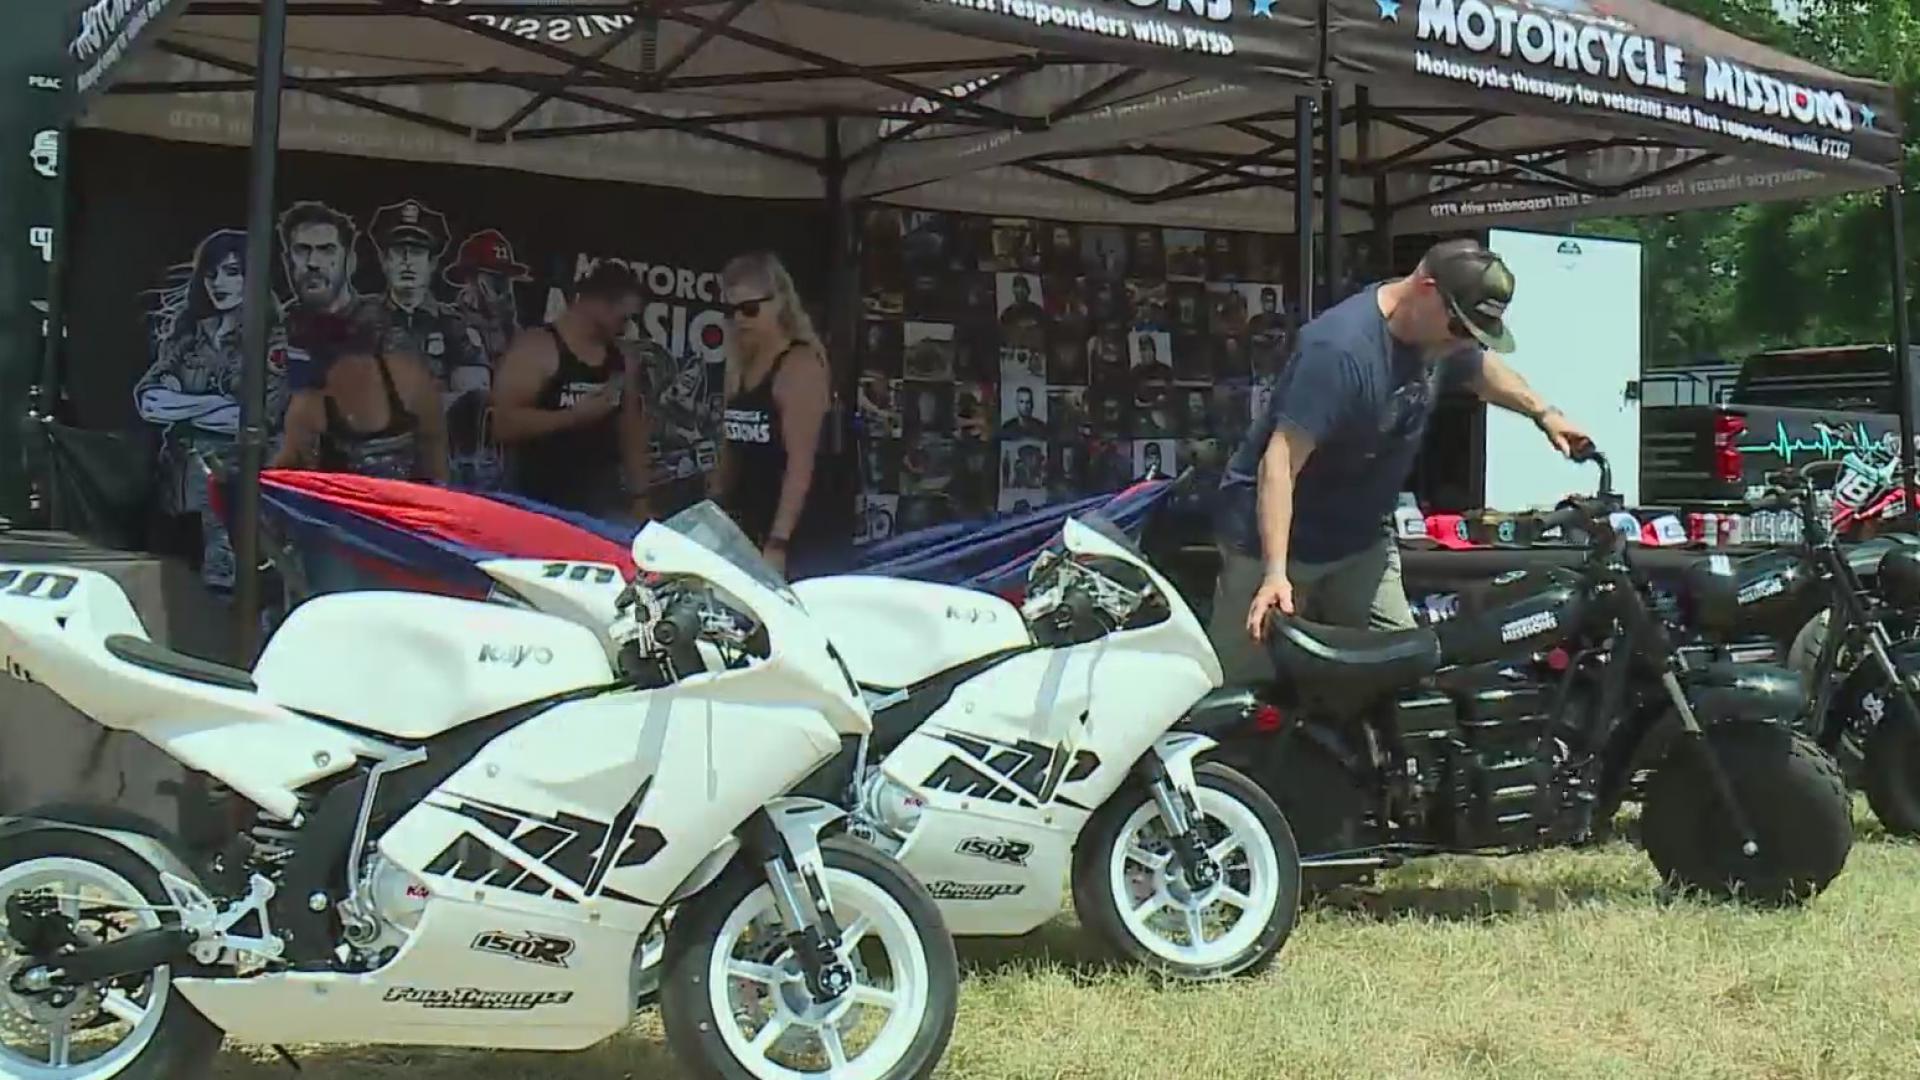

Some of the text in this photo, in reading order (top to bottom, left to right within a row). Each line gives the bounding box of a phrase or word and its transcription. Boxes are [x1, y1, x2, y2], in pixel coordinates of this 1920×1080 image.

[1000, 3, 1127, 37] responders
[1131, 20, 1179, 47] with
[1182, 26, 1234, 55] PTSD
[1415, 50, 1511, 88] Motorcycle
[1510, 71, 1574, 103] therapy
[1574, 83, 1601, 105] for
[1665, 102, 1691, 125] and
[1693, 108, 1720, 132] first
[1417, 0, 1854, 132] MOTORCYCLE MISSIONS
[574, 253, 725, 302] MTORC
[472, 931, 577, 968] 150R
